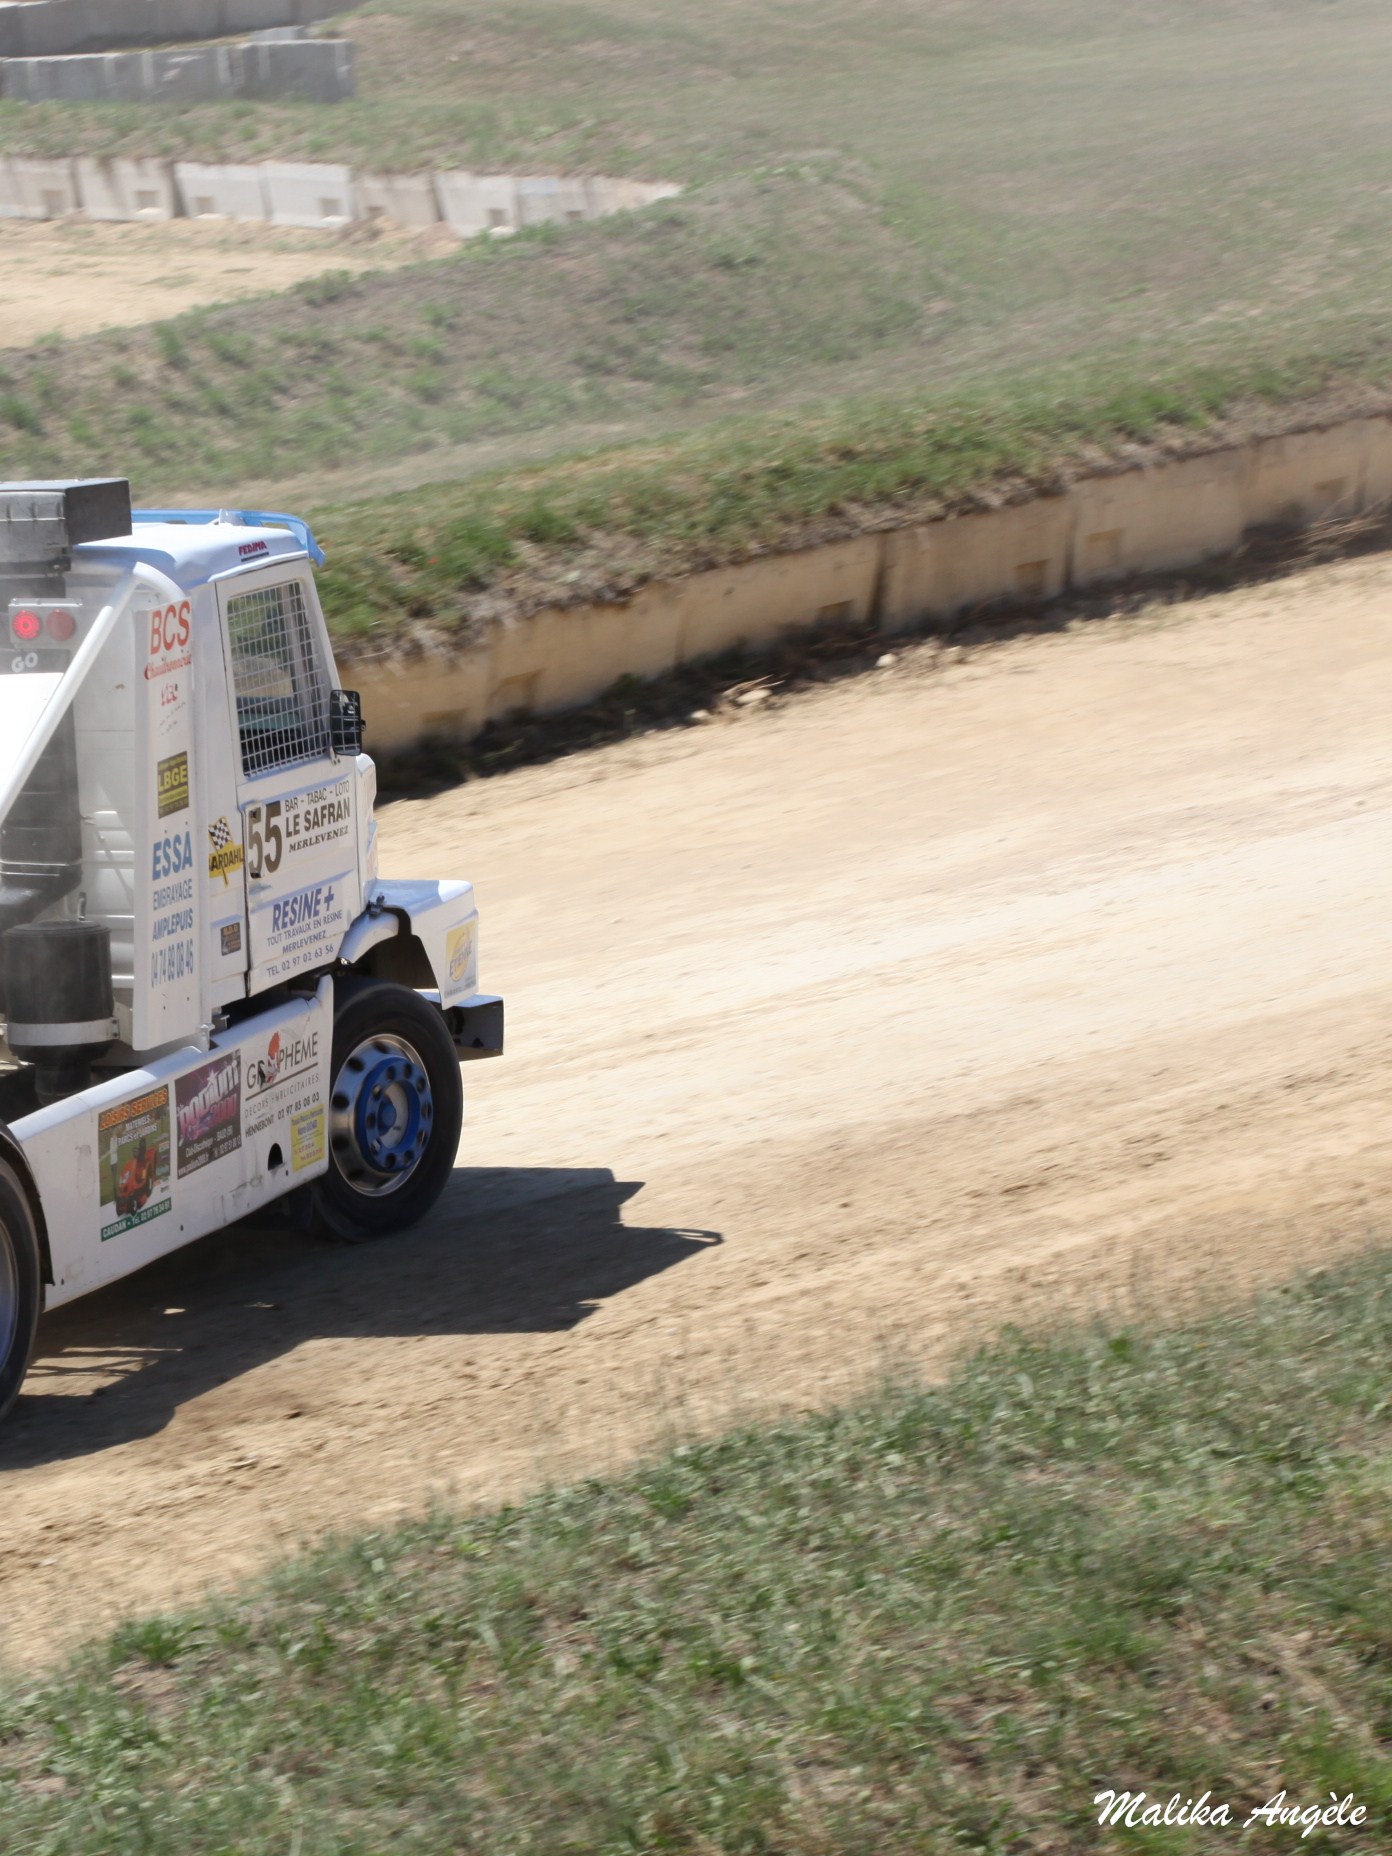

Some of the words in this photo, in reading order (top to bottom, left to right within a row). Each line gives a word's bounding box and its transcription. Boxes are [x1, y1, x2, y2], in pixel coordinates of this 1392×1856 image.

[150, 600, 191, 655] BCS
[158, 765, 188, 793] LBGE
[285, 797, 299, 812] BAR
[307, 788, 328, 805] TABAC
[335, 781, 350, 797] LOTO
[285, 813, 300, 838] LE
[304, 797, 351, 832] SAFRAN
[248, 800, 283, 879] 55
[289, 825, 349, 853] MERLEVENEZ
[152, 831, 193, 881] ESSA
[209, 847, 244, 872] ARDAHL
[153, 878, 193, 911] EMBRAYAGE
[152, 907, 193, 942] AMPLEPUIS
[267, 933, 283, 947] TOUT
[284, 923, 312, 941] TRAVAUX
[313, 919, 322, 929] EN
[282, 930, 327, 955] MERLEVENEZ
[266, 967, 280, 977] TEL
[281, 960, 290, 971] 02
[293, 956, 300, 967] 97
[303, 952, 312, 962] 02
[314, 947, 323, 958] 63
[325, 943, 334, 954] 56
[245, 1114, 275, 1138] HENNEBONT
[277, 1110, 285, 1120] 02
[286, 1106, 293, 1116] 97
[102, 1219, 127, 1239] CAUDAN
